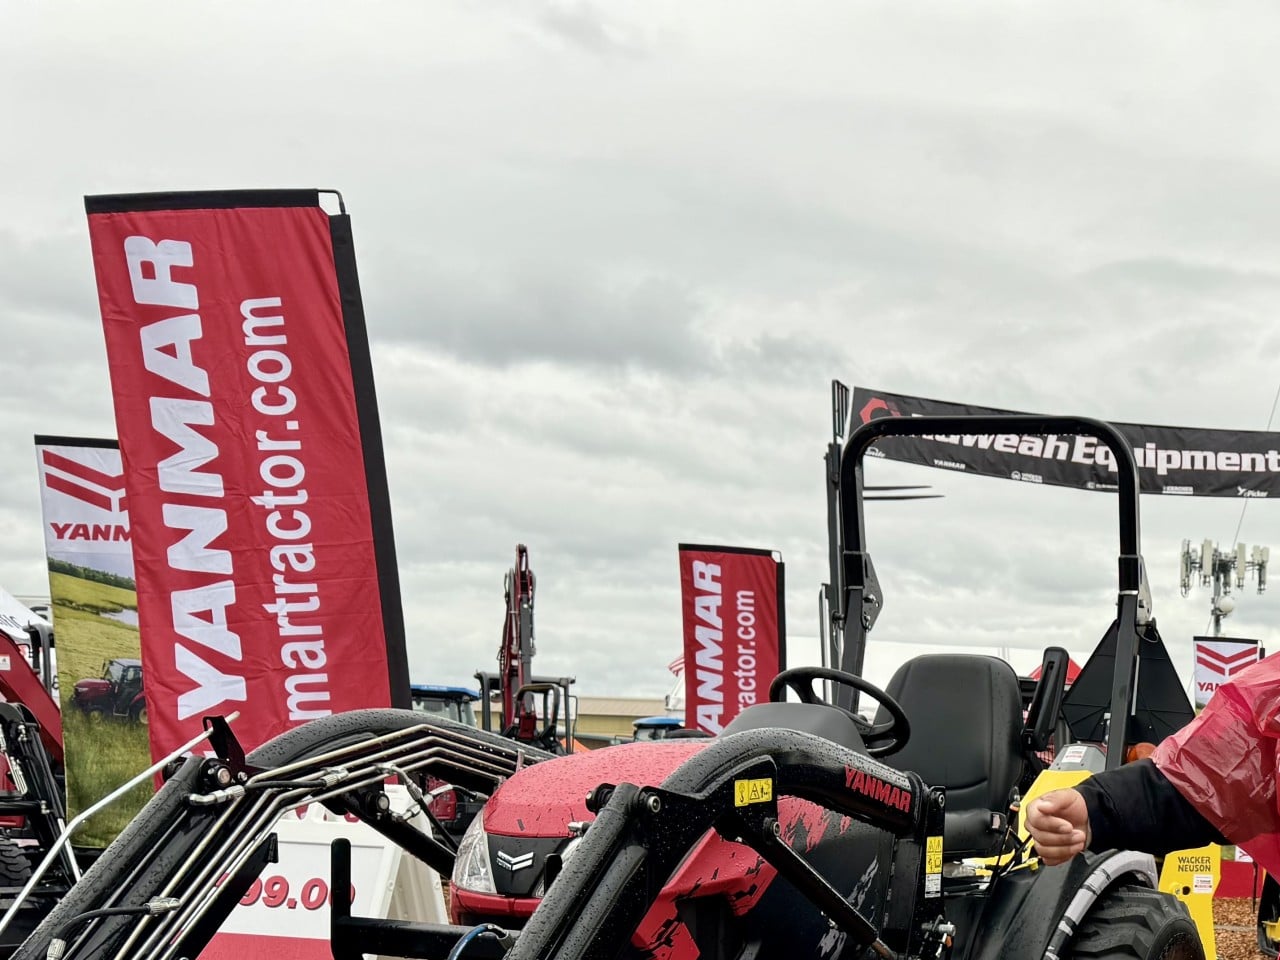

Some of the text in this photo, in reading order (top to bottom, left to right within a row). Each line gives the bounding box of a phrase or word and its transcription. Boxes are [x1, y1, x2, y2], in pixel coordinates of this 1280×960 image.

[124, 236, 247, 720] YANMAR
[692, 560, 724, 737] ANMAR
[844, 764, 912, 813] YANMAR
